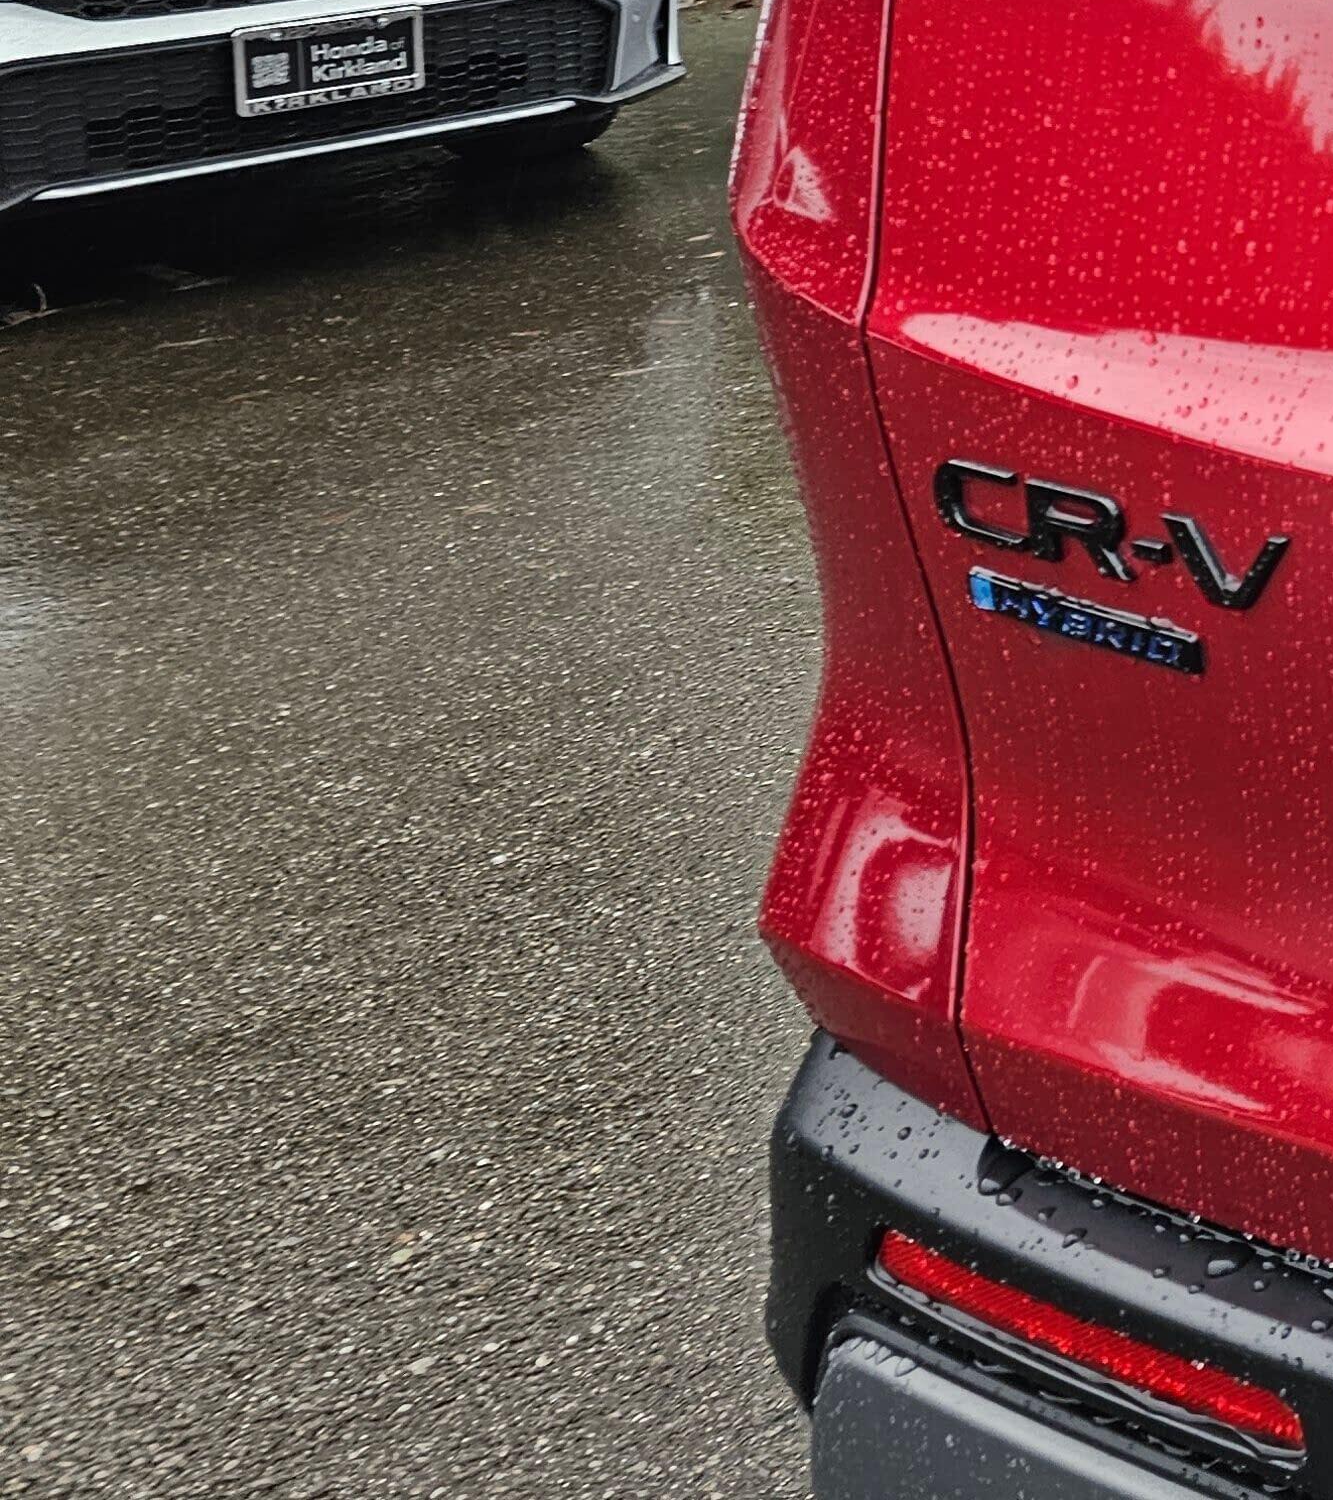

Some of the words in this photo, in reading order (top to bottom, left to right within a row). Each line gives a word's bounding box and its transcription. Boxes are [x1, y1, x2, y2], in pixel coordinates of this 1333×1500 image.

[310, 36, 388, 62] Honda
[311, 51, 408, 83] Kirkland
[933, 458, 1292, 611] CR-V
[1000, 588, 1181, 664] HYBRID
